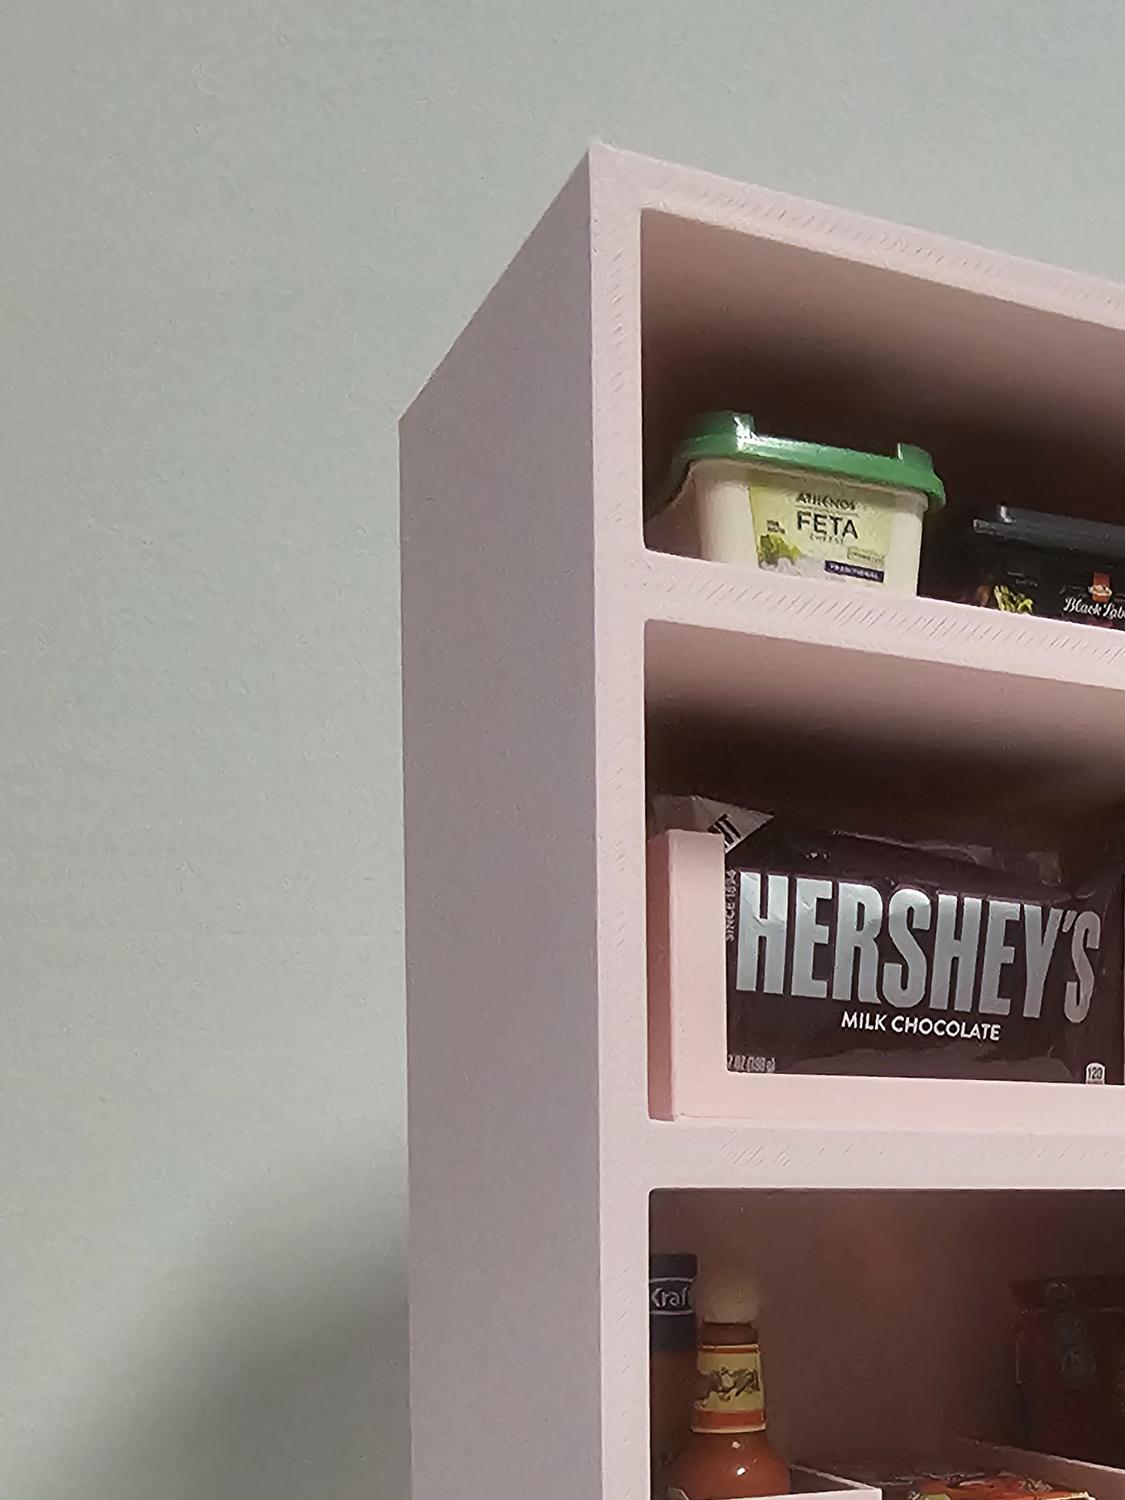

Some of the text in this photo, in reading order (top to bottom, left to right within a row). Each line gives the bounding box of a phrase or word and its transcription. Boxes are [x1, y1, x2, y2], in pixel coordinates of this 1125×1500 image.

[797, 510, 858, 539] FETA
[1063, 596, 1101, 617] Black
[735, 871, 1102, 1024] HERSHEY'S
[841, 1010, 1002, 1041] MILK CHOCOLATE
